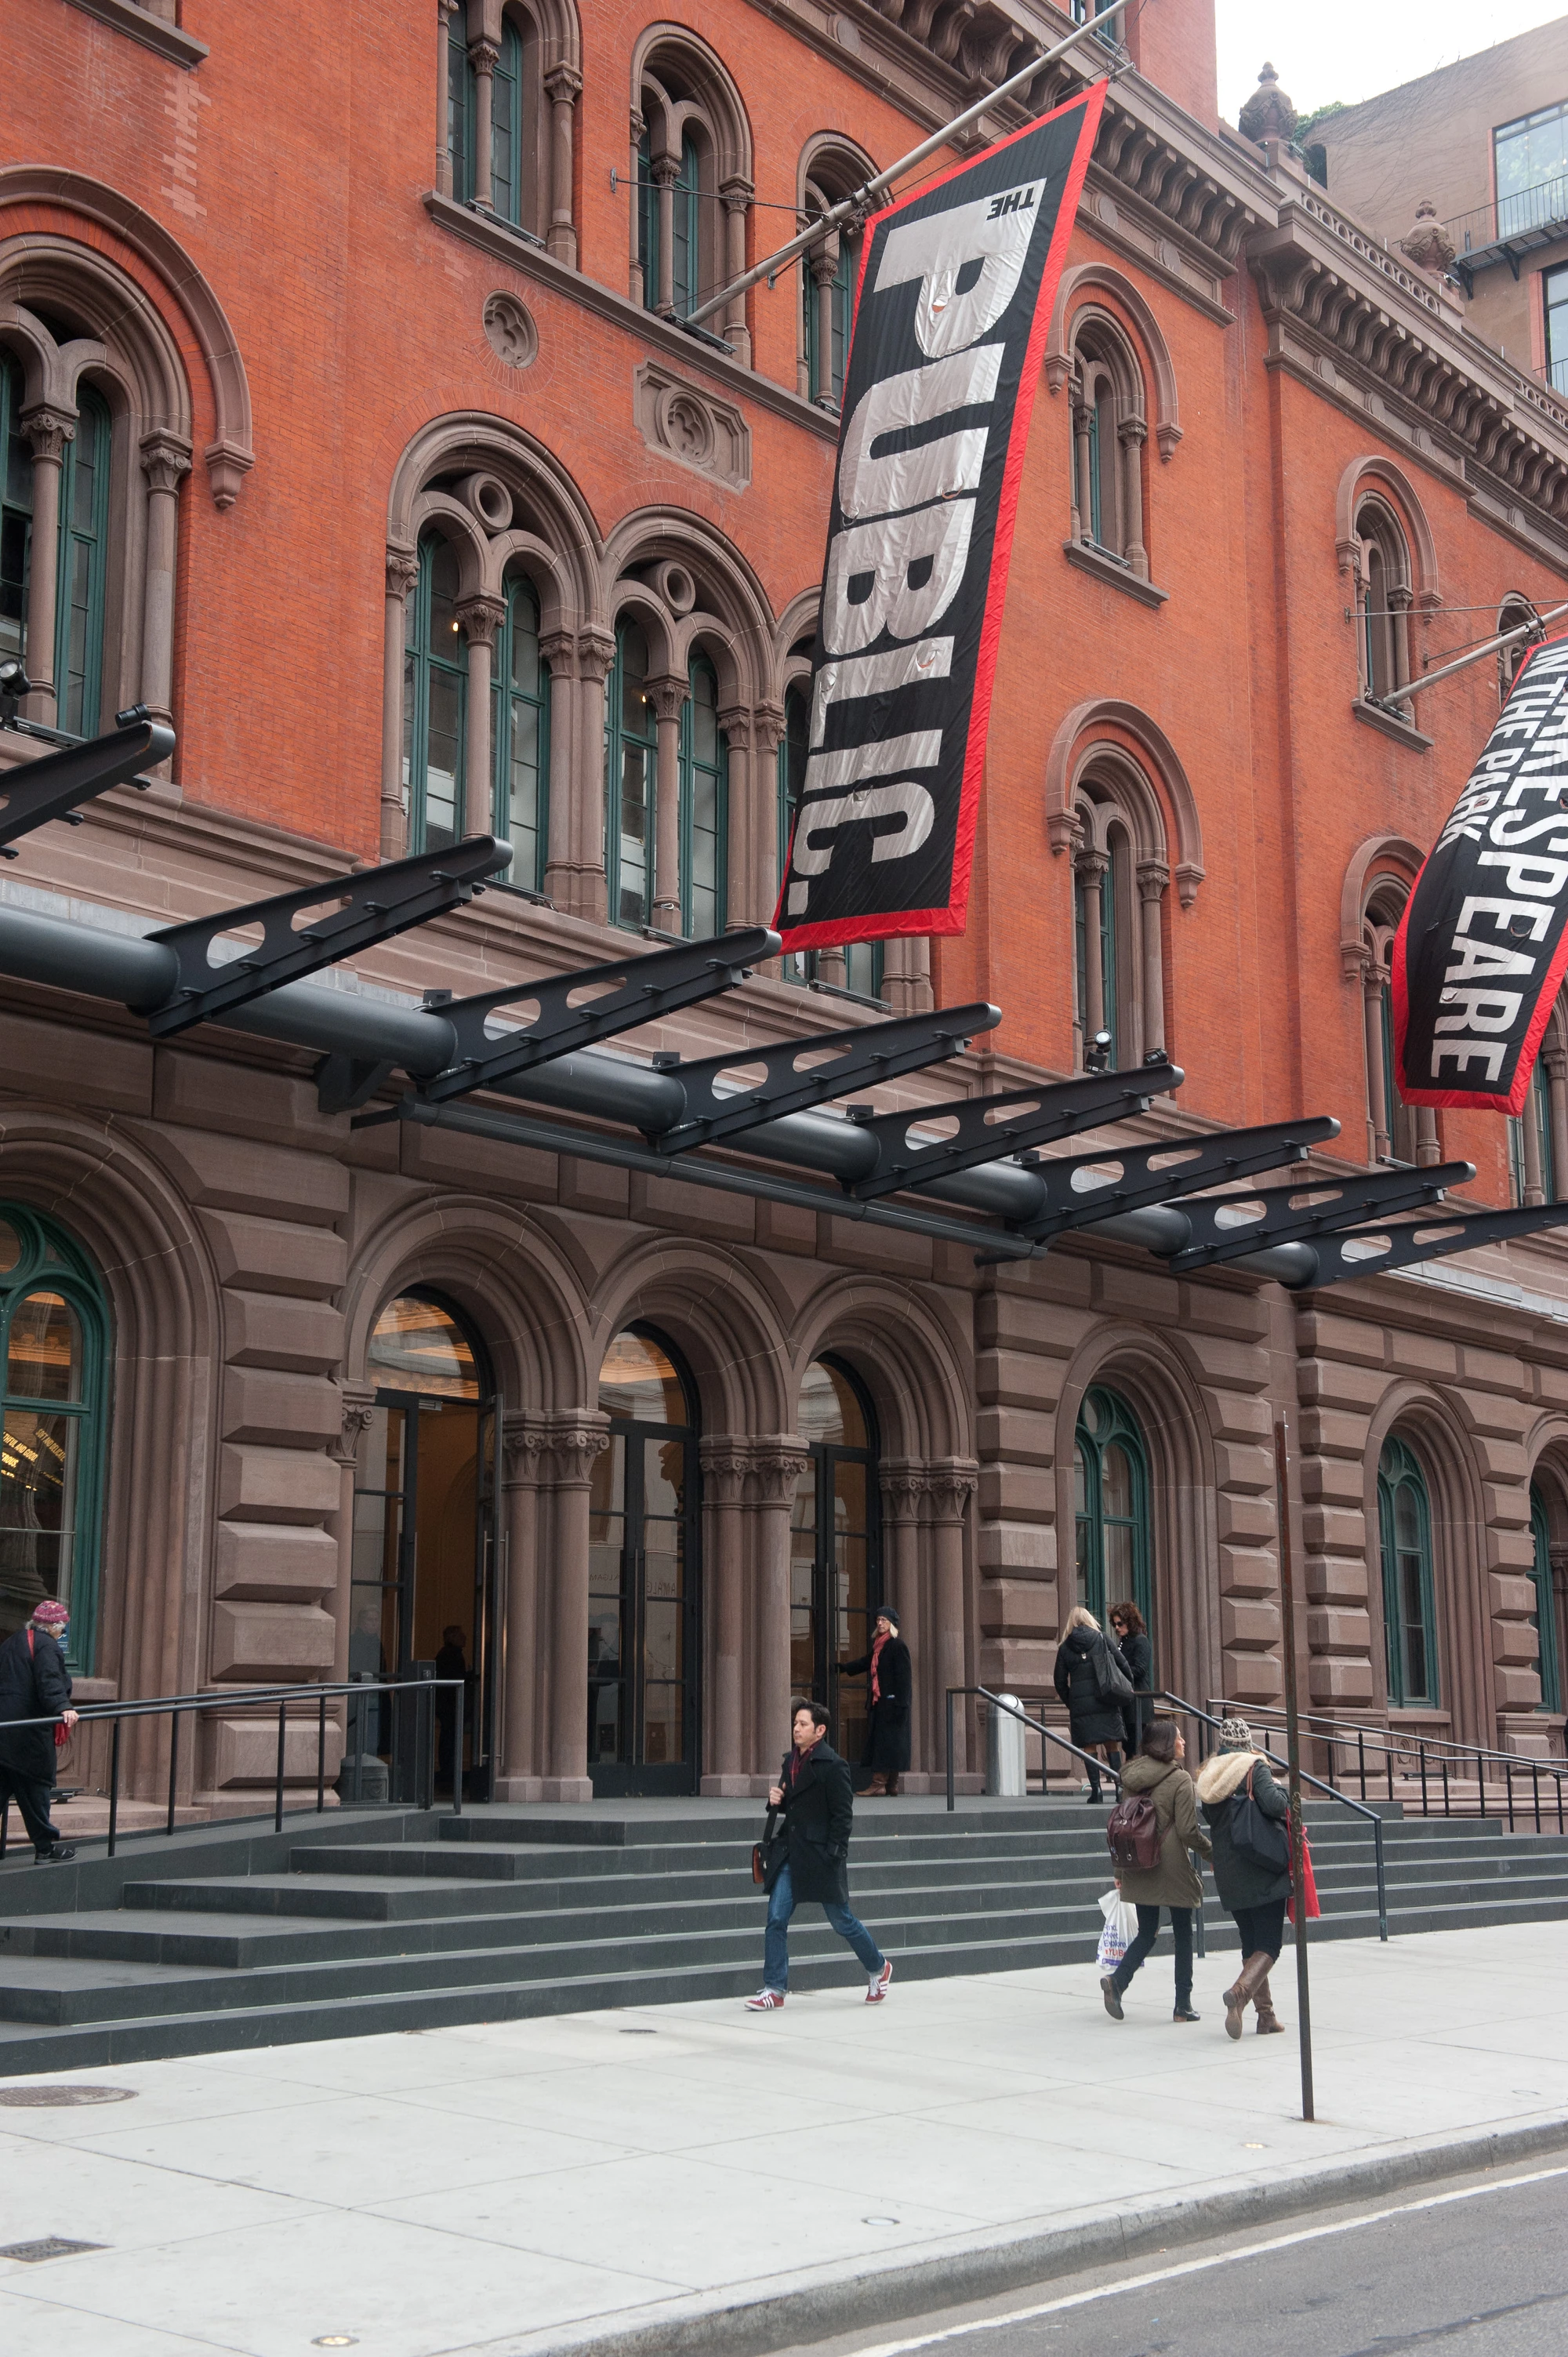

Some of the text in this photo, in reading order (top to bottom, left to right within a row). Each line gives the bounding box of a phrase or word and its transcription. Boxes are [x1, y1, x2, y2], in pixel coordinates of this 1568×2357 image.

[986, 187, 1035, 220] THE
[789, 177, 1047, 916] PUBLIC.
[1436, 645, 1568, 854] IN THE PARK
[3, 1432, 19, 1447] THFUL
[14, 1443, 27, 1454] AND
[43, 1436, 54, 1447] AND
